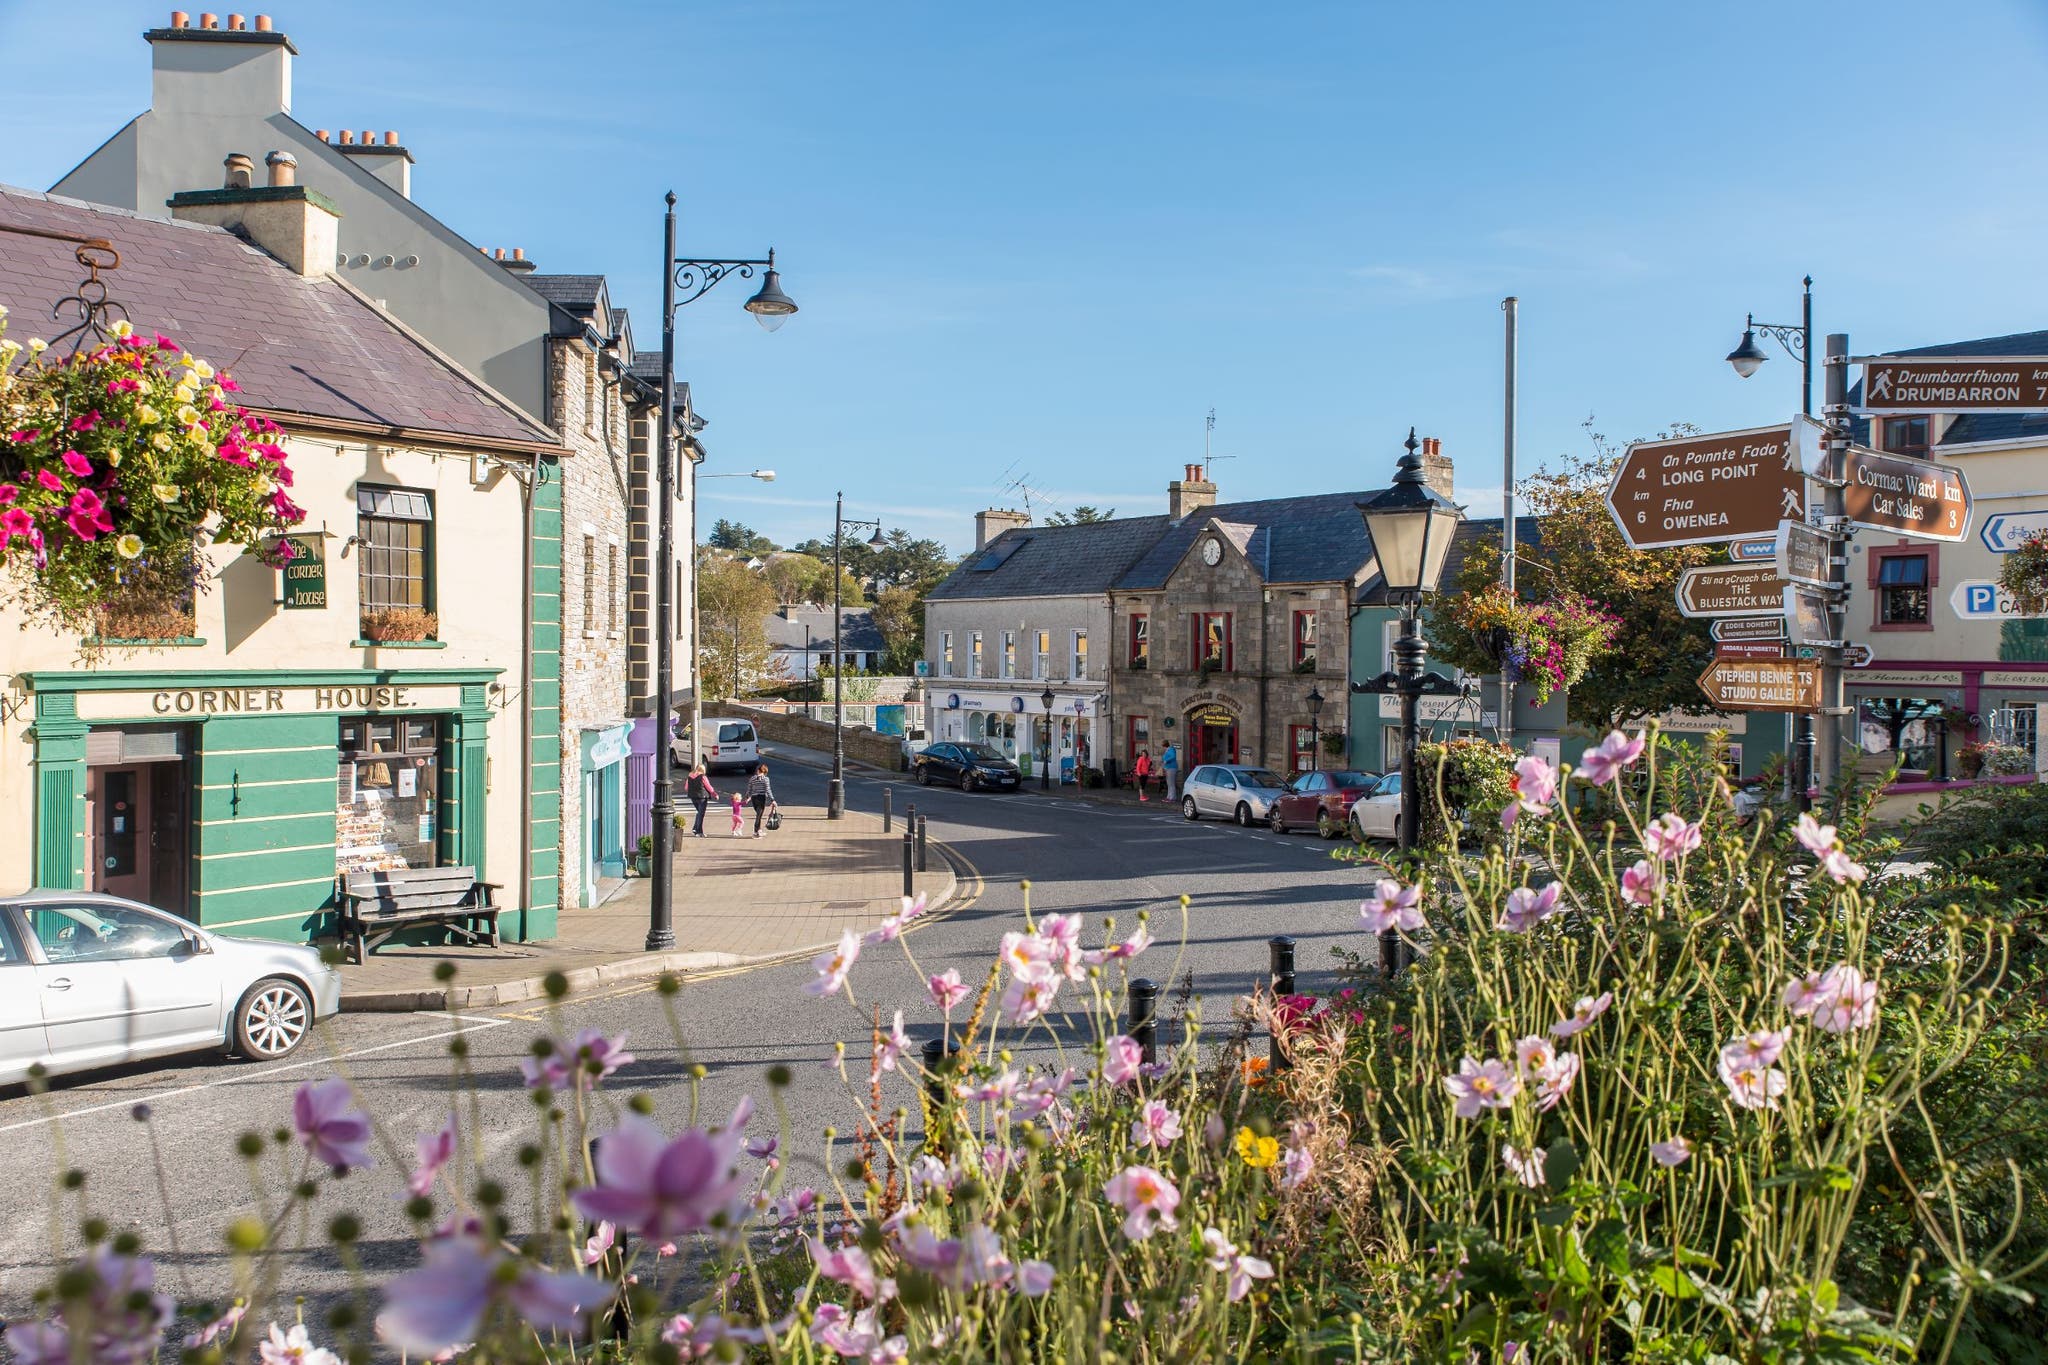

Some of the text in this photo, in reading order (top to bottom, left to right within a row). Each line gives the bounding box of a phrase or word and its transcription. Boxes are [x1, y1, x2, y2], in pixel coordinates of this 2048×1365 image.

[1898, 369, 2020, 384] Druimbarrfhionn
[1895, 387, 2047, 401] DRUMBARRON 7
[1662, 443, 1778, 468] An Poinnte Fada
[1636, 463, 1759, 486] 4 LONG POINT
[1857, 464, 1962, 503] Cormac Ward km
[1634, 491, 1650, 501] km
[1663, 498, 1694, 512] Fhia
[1872, 493, 1957, 529] Car Sales 3
[1637, 511, 1729, 530] 6 OWENEA
[1714, 577, 1724, 585] na
[1725, 574, 1759, 586] gCruach
[295, 587, 325, 606] house
[1732, 584, 1750, 595] THE
[1700, 595, 1783, 608] BLUESTACK WAY
[1725, 621, 1777, 629] EDDIE DOHERTY
[1715, 670, 1813, 684] STEPHEN BENNETS
[1721, 686, 1757, 699] STUDIO
[152, 687, 418, 714] CORNER HOUSE.
